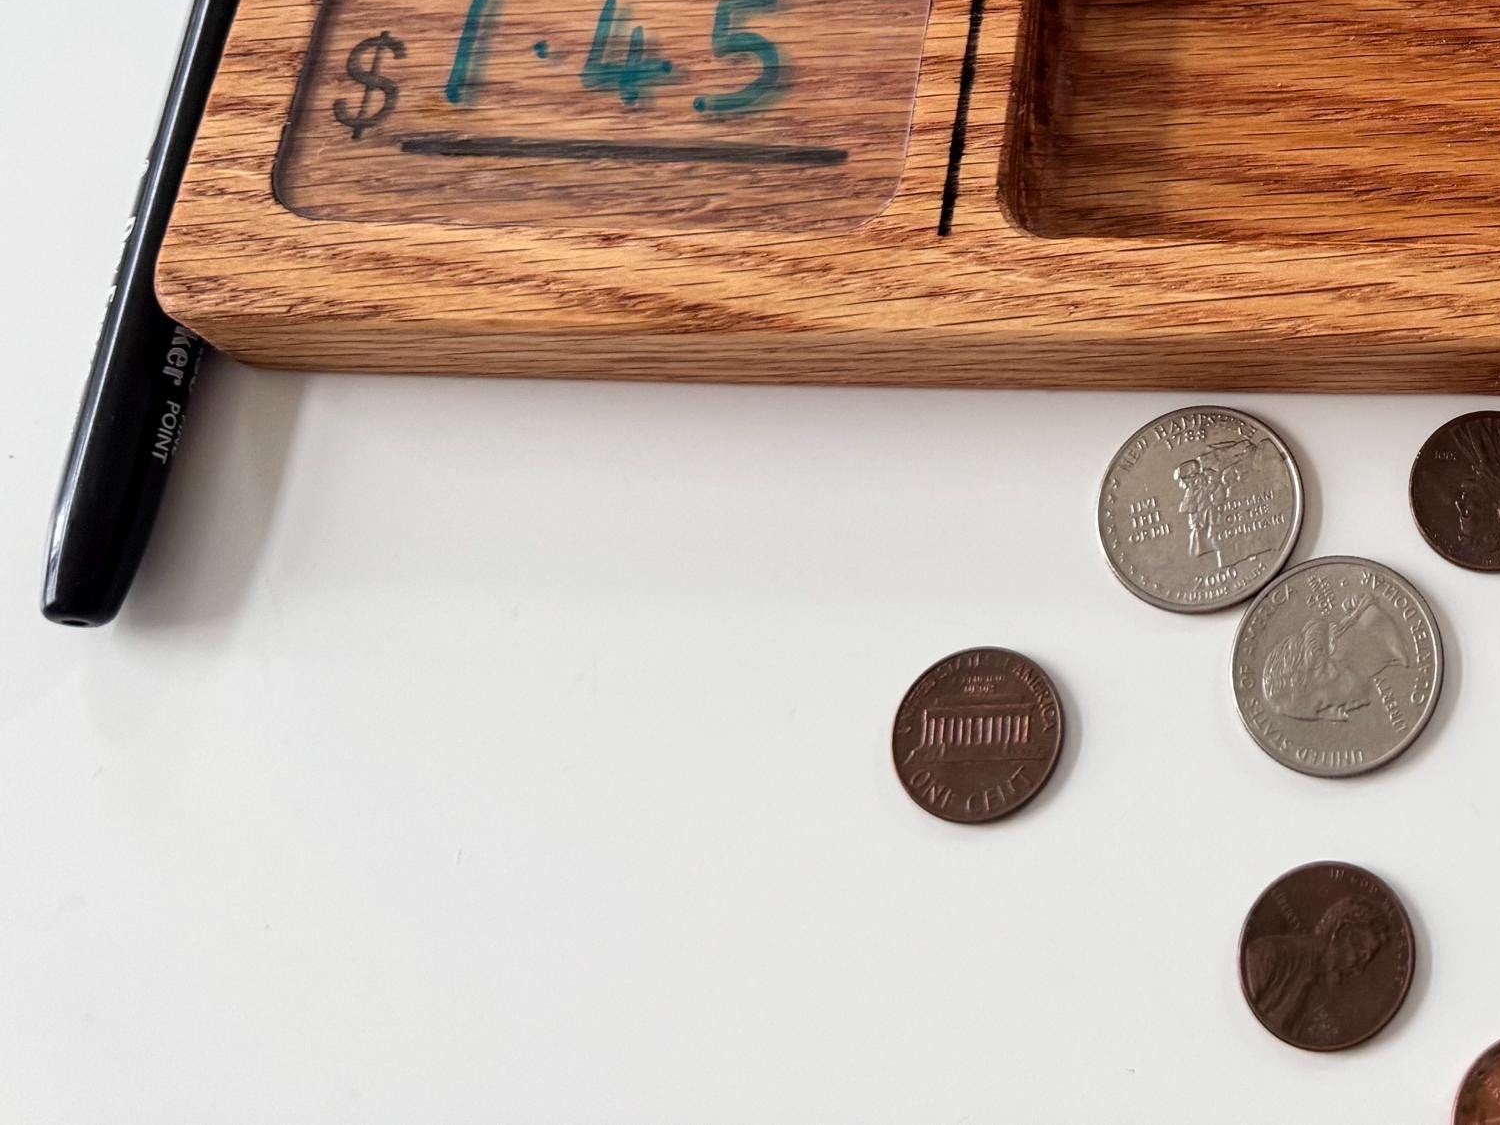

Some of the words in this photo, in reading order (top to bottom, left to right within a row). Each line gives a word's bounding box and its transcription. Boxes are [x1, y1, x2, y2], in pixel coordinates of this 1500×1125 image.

[332, 29, 408, 142] $
[151, 399, 182, 465] POINT
[1119, 438, 1150, 473] NEW
[908, 769, 957, 811] ONE
[965, 764, 1033, 813] CENT
